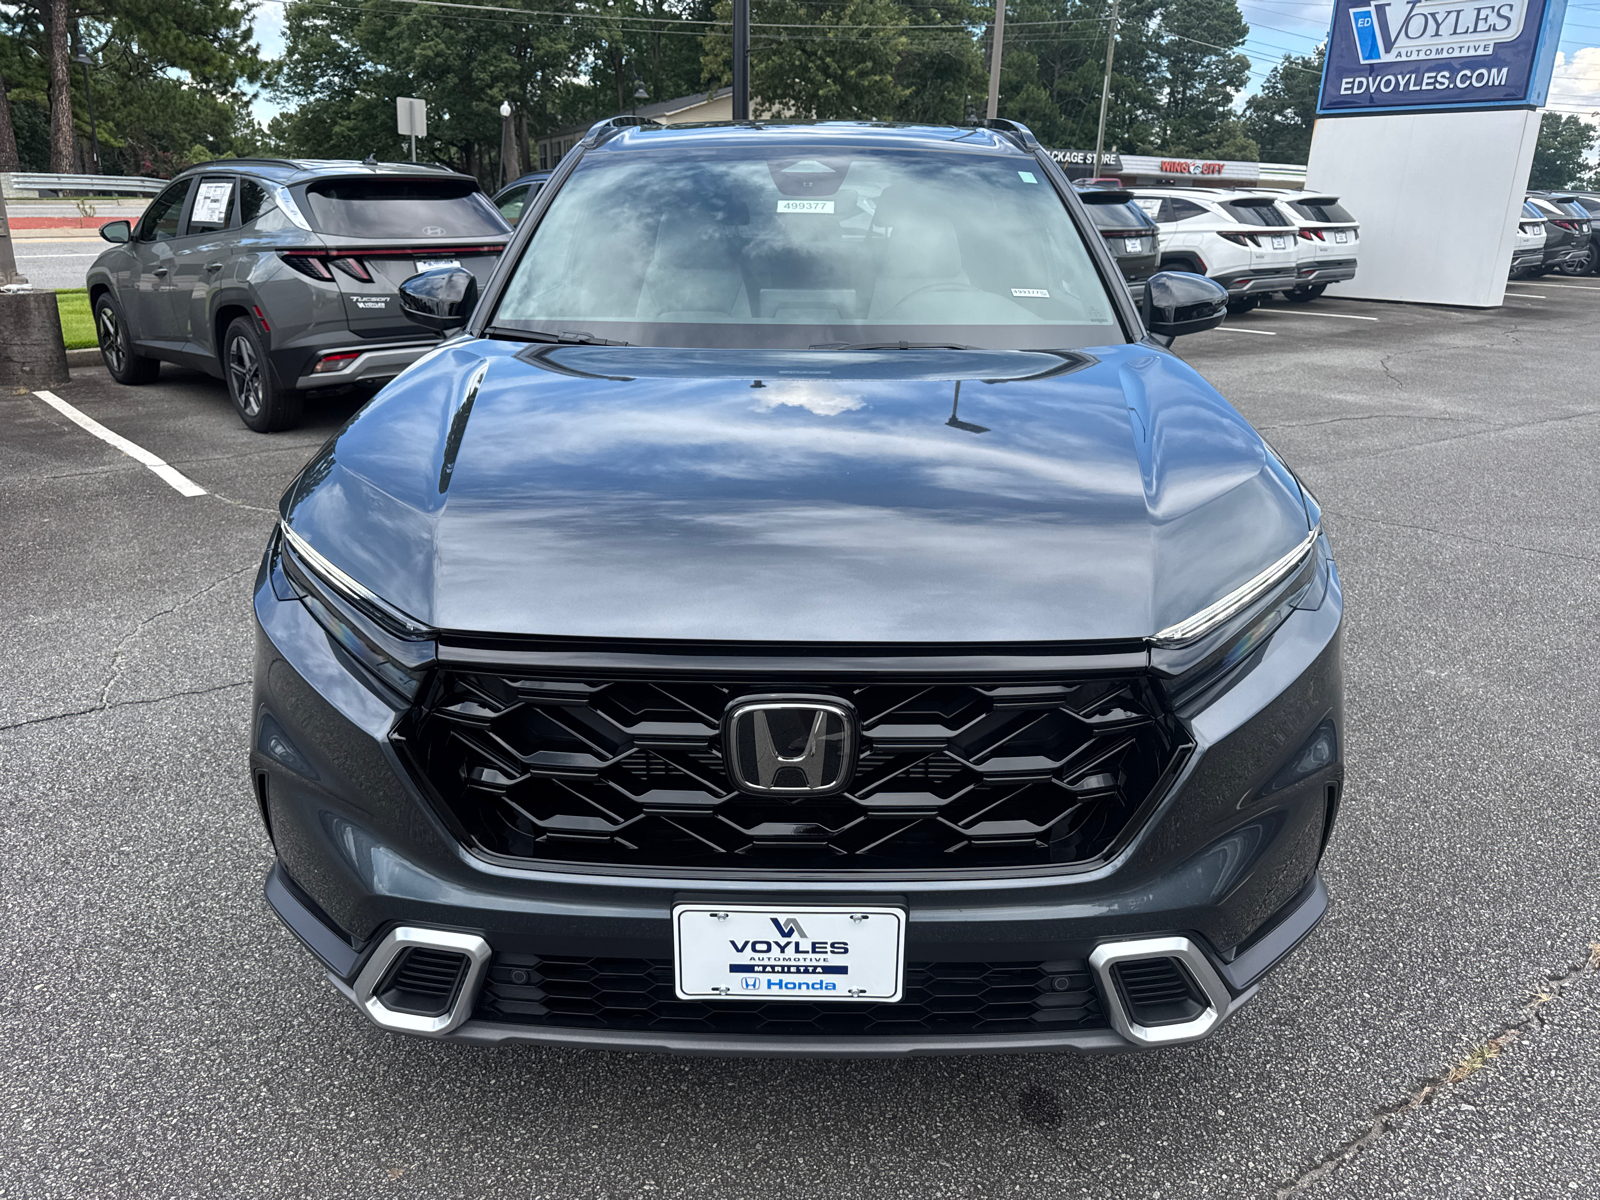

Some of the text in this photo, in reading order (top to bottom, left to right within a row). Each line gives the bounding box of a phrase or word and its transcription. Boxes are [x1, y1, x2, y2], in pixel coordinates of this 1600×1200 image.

[1357, 18, 1371, 27] ED
[1374, 0, 1514, 54] VOYLES
[1395, 44, 1491, 59] AUTOMOTIVE
[1340, 67, 1509, 95] EDVOYLES.COM
[1047, 150, 1117, 165] CKAGE STRE
[1161, 160, 1225, 174] WING CITY
[783, 202, 827, 210] 499377
[729, 940, 850, 955] VOYLES
[754, 965, 824, 973] MARIETTA
[766, 978, 837, 991] Honda
